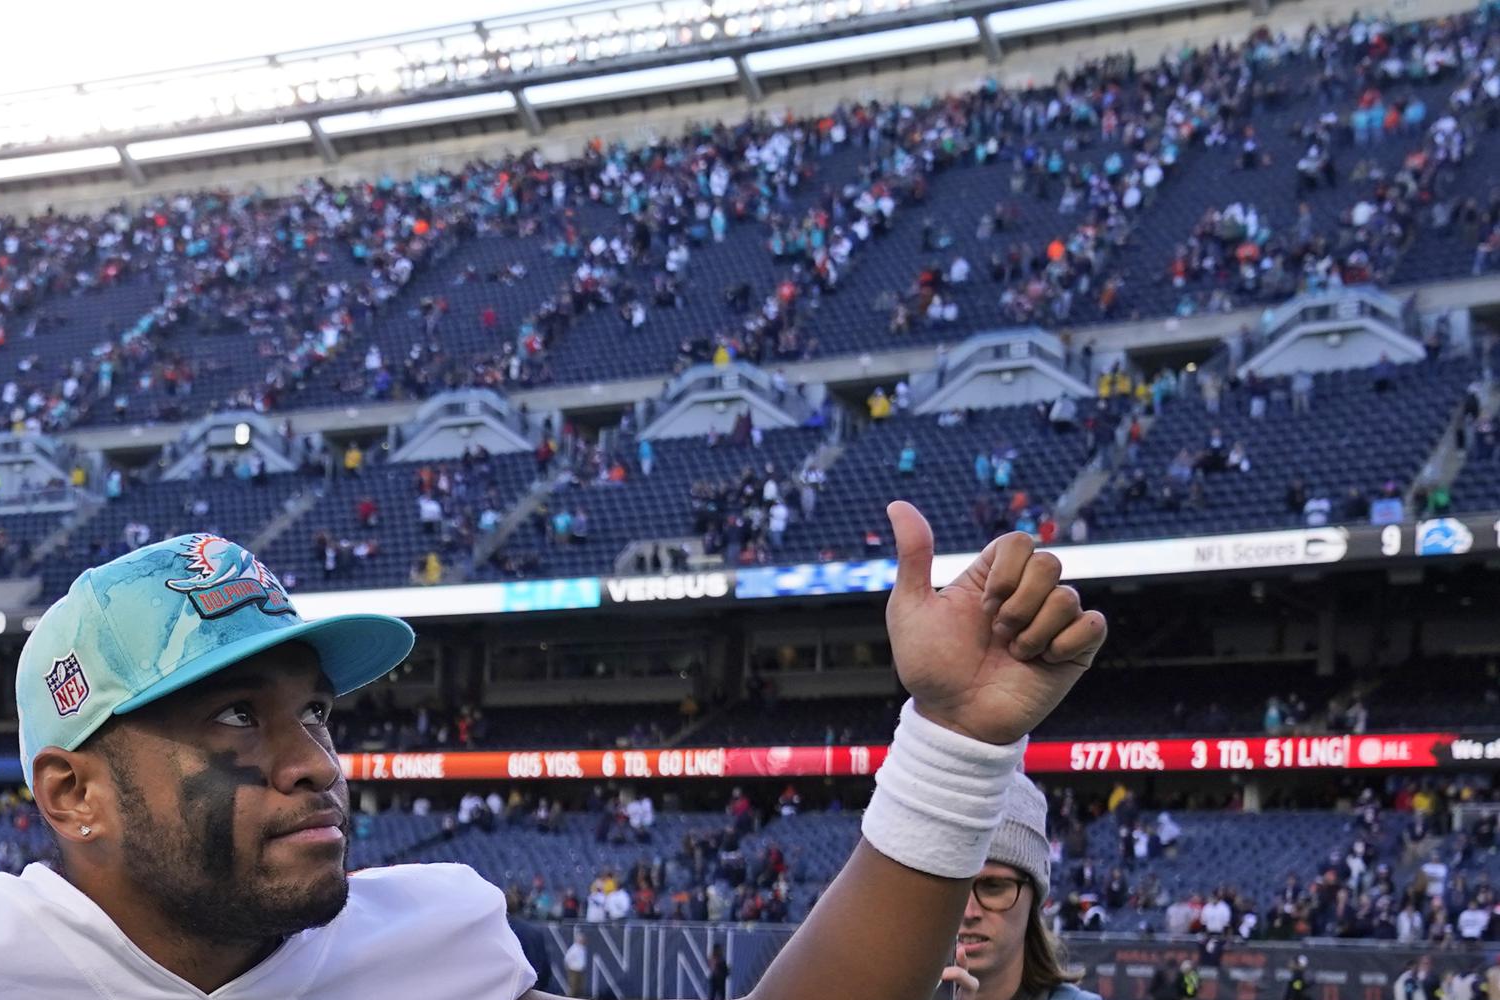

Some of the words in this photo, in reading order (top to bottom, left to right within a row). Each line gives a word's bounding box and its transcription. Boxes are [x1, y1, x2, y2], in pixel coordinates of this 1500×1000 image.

[1234, 541, 1296, 562] Scores
[198, 581, 262, 612] DOLPHINS
[607, 572, 729, 603] VERSUS
[53, 675, 87, 711] NFL
[392, 753, 445, 779] CHASE
[684, 749, 720, 777] LNG
[1070, 742, 1113, 770] 577
[1191, 740, 1208, 769] 3
[1264, 738, 1293, 768] 51
[1297, 737, 1342, 767] LNG
